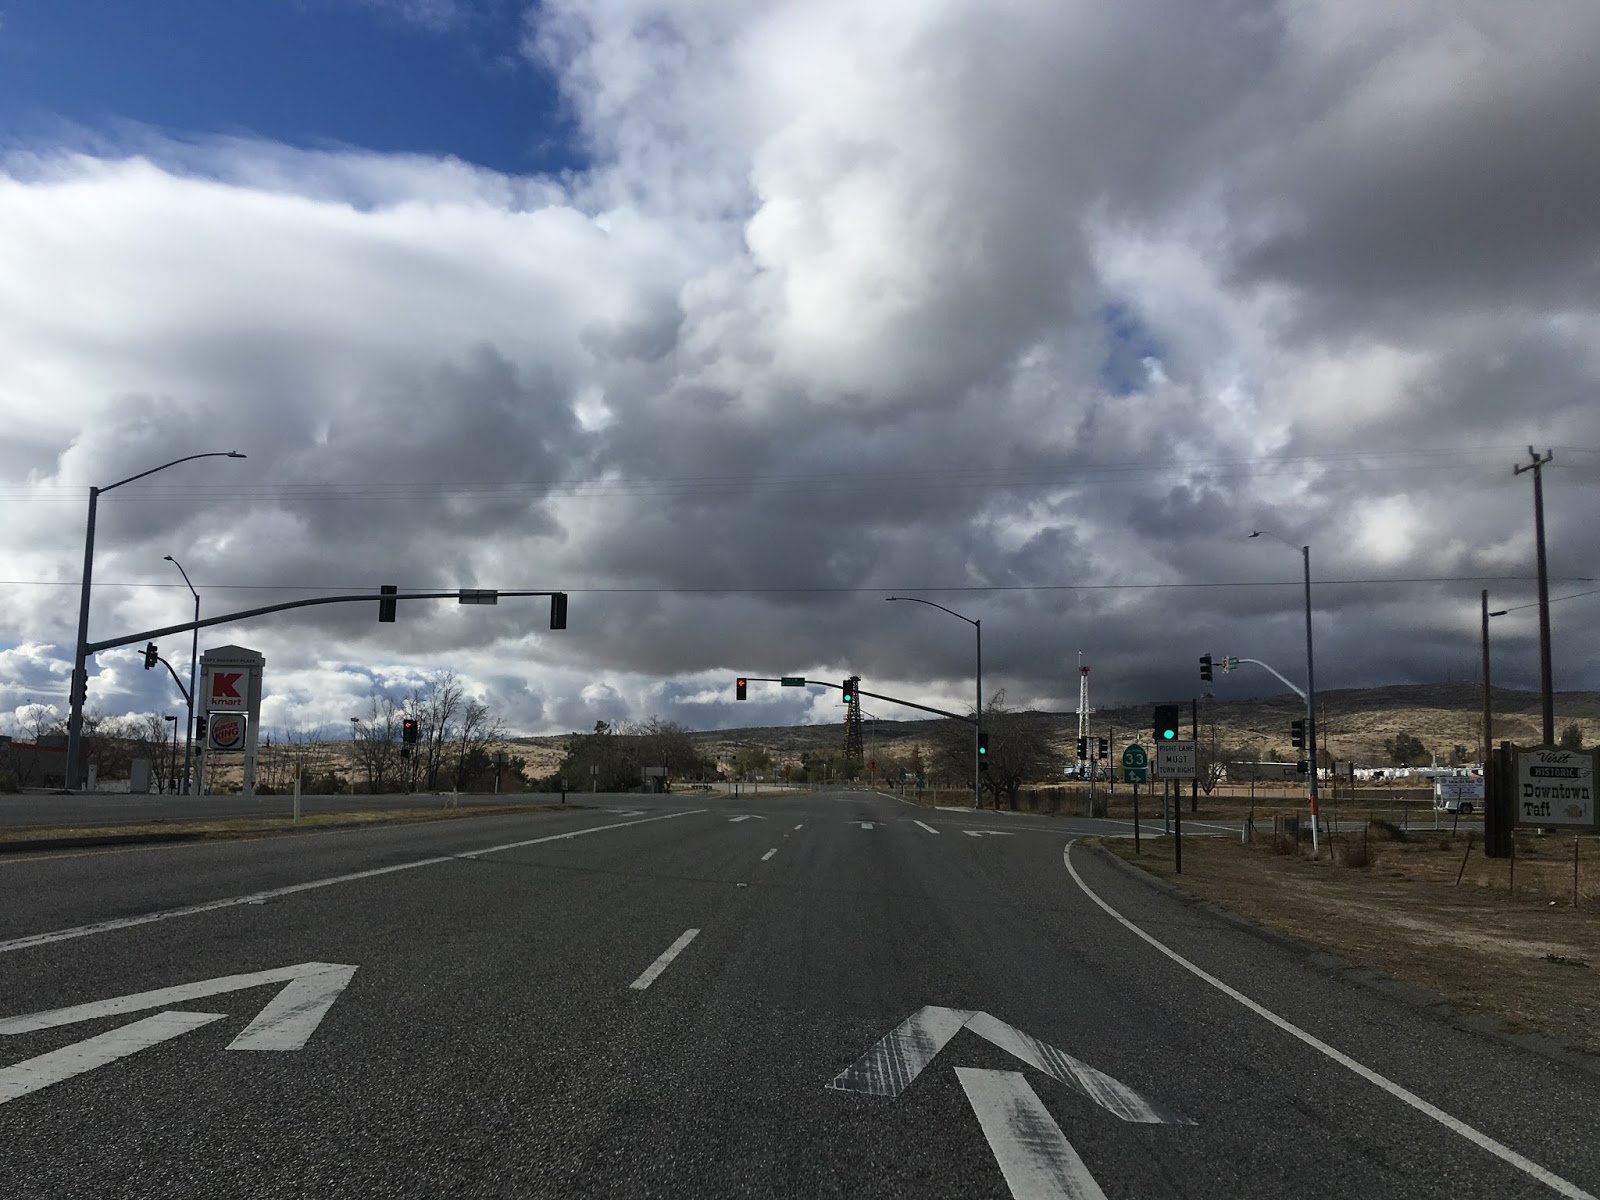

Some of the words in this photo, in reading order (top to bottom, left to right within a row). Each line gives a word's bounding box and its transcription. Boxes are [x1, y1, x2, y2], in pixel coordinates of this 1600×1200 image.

[212, 672, 243, 698] K
[211, 697, 242, 706] kmart
[214, 721, 239, 732] BURGER
[214, 727, 239, 741] KING
[1125, 753, 1144, 765] 33
[1166, 755, 1188, 763] MUST
[1536, 752, 1573, 764] Visit
[1535, 767, 1575, 777] HISTORIC
[1523, 783, 1590, 800] Downtown
[1523, 801, 1551, 817] Taft
